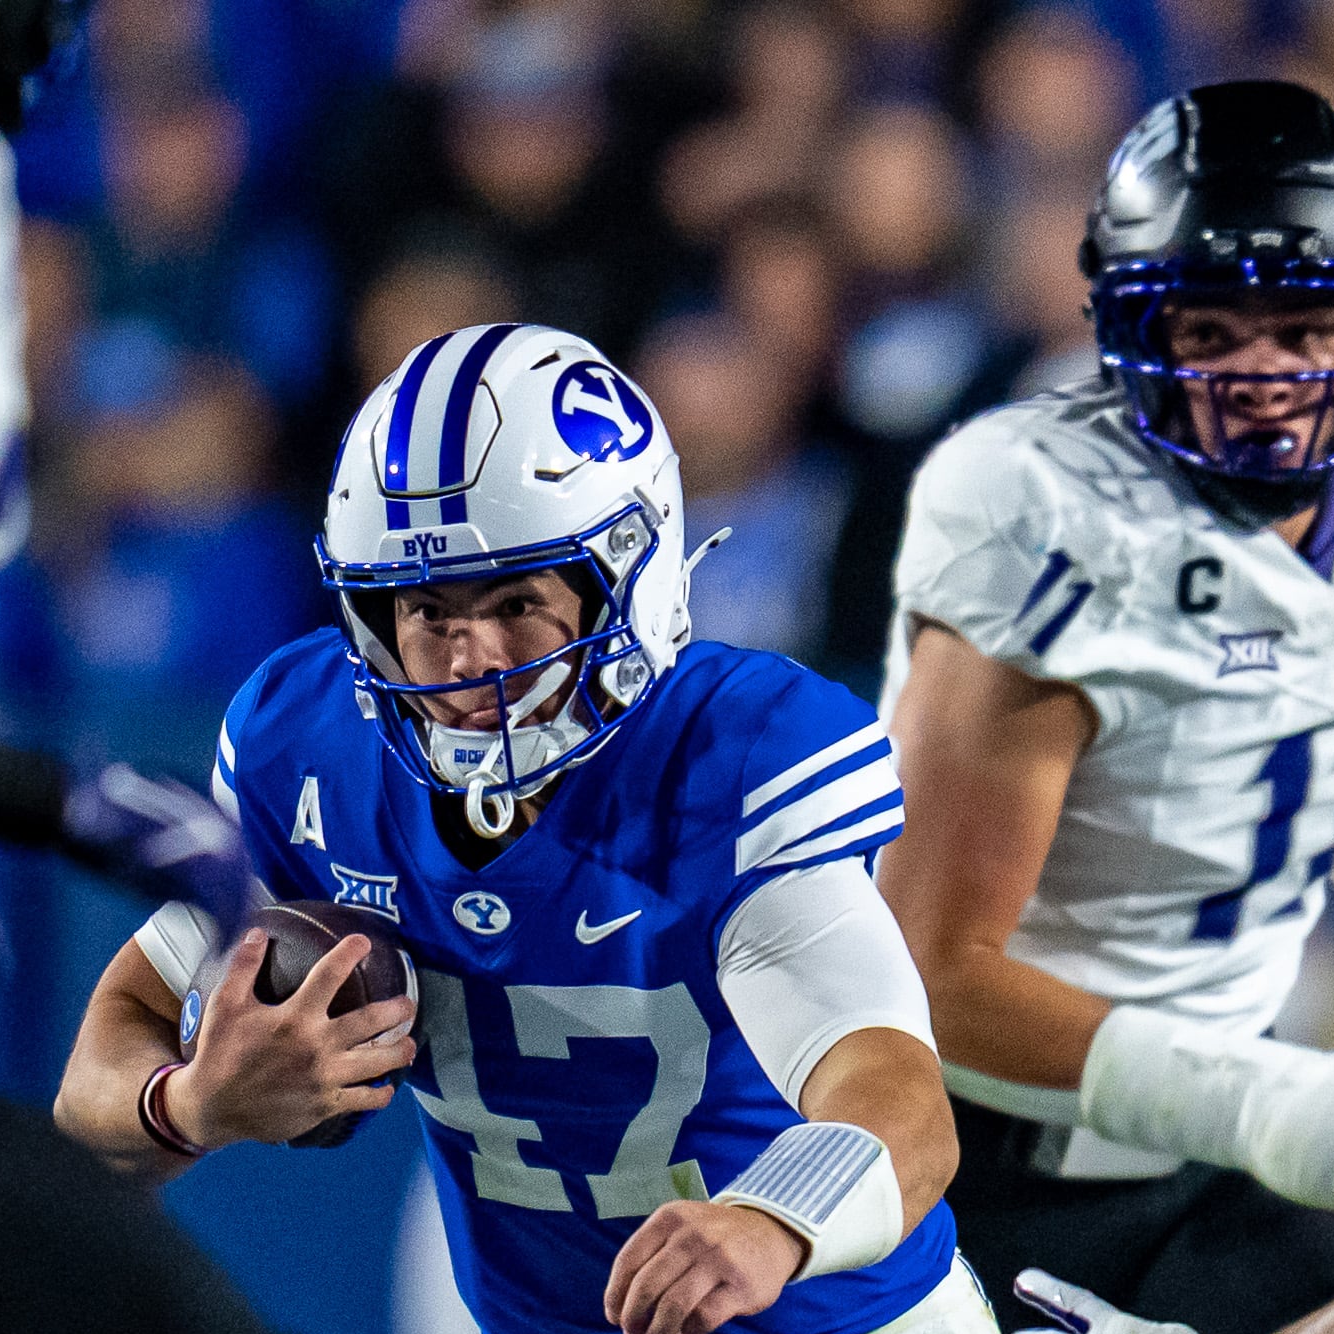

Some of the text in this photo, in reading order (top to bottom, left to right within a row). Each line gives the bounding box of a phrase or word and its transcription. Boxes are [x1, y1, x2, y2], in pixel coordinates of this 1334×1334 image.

[560, 366, 646, 451] Y
[402, 532, 448, 558] BYU
[1012, 549, 1095, 657] 11
[1178, 557, 1224, 614] C
[290, 776, 326, 850] A
[460, 896, 503, 931] Y
[405, 967, 712, 1220] 47
